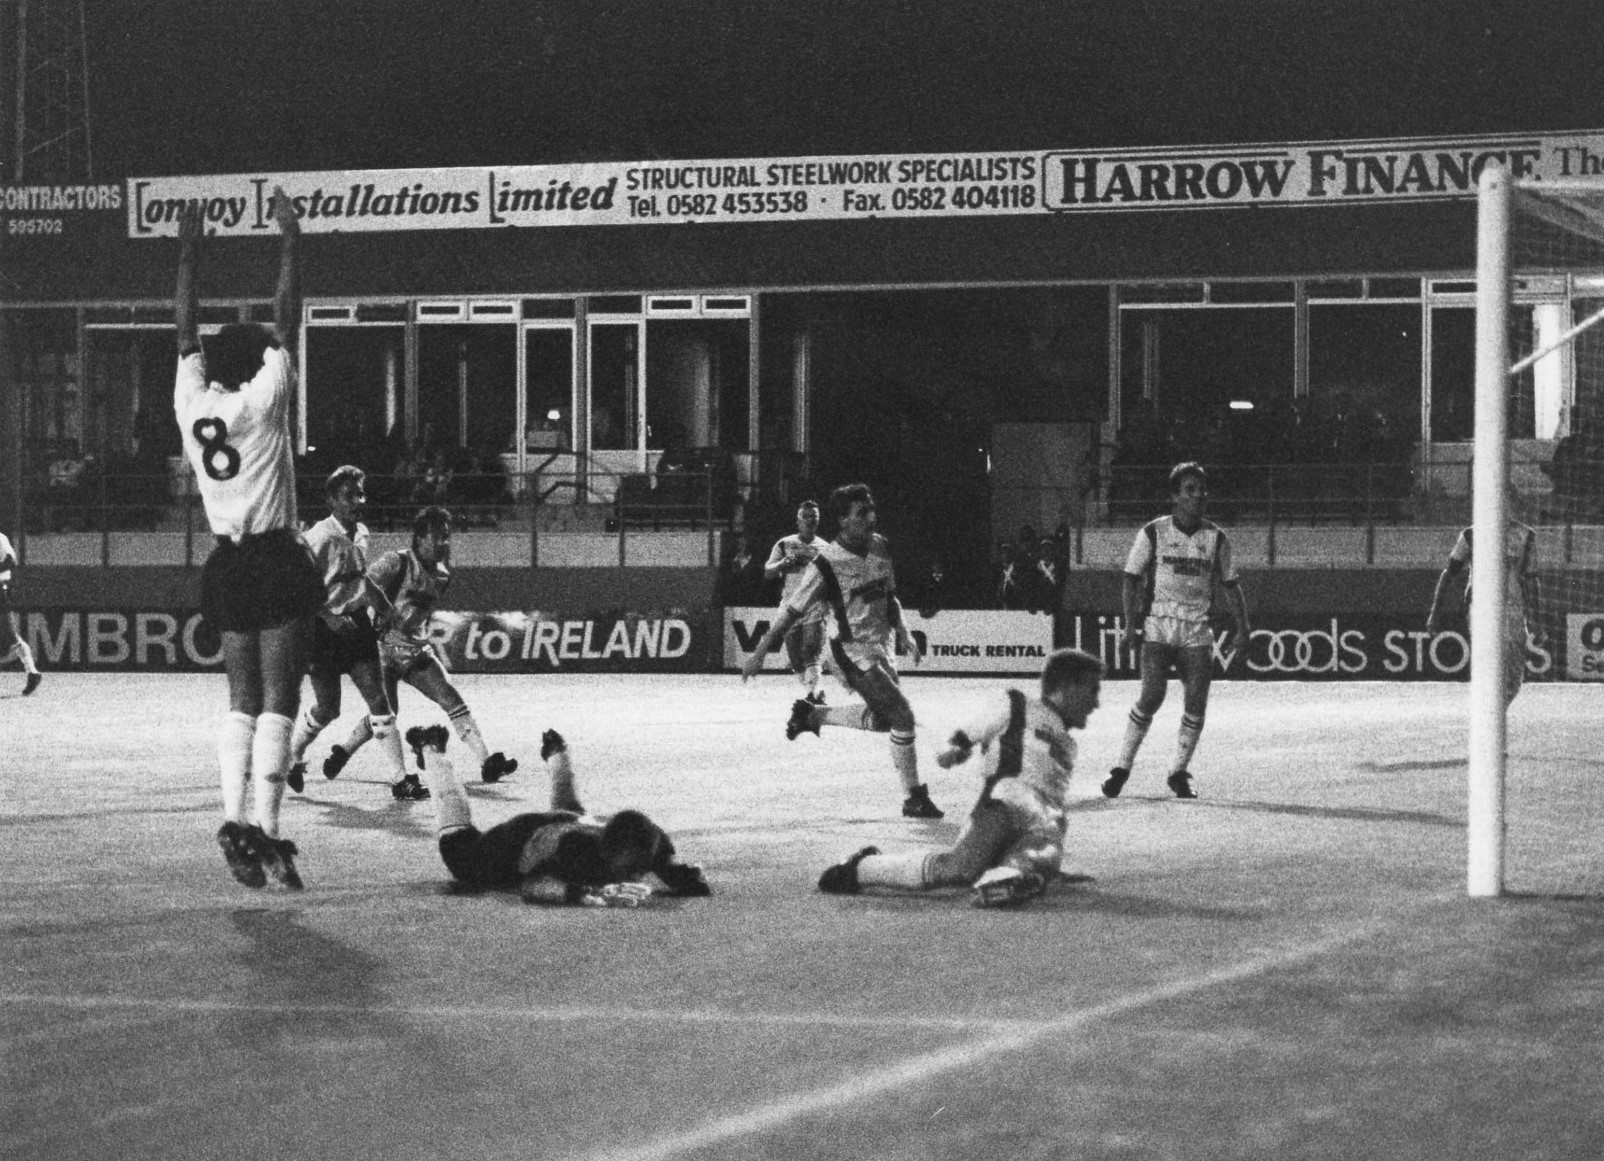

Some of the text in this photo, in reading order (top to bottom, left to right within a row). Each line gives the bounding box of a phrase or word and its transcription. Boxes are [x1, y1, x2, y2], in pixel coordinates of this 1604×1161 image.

[626, 156, 1036, 191] STRUCTURAL STEELWORK SPECIALISTS
[1060, 157, 1296, 204] HARROW
[1553, 145, 1604, 176] Th
[488, 170, 619, 224] Limited
[628, 184, 1036, 218] Tel. 0582 453538 Fax. 0582 404118
[192, 416, 241, 482] 8
[465, 621, 512, 661] to
[521, 619, 692, 668] IRELAND
[931, 644, 1046, 658] TRUCK RENTAL
[1382, 629, 1552, 673] STOS
